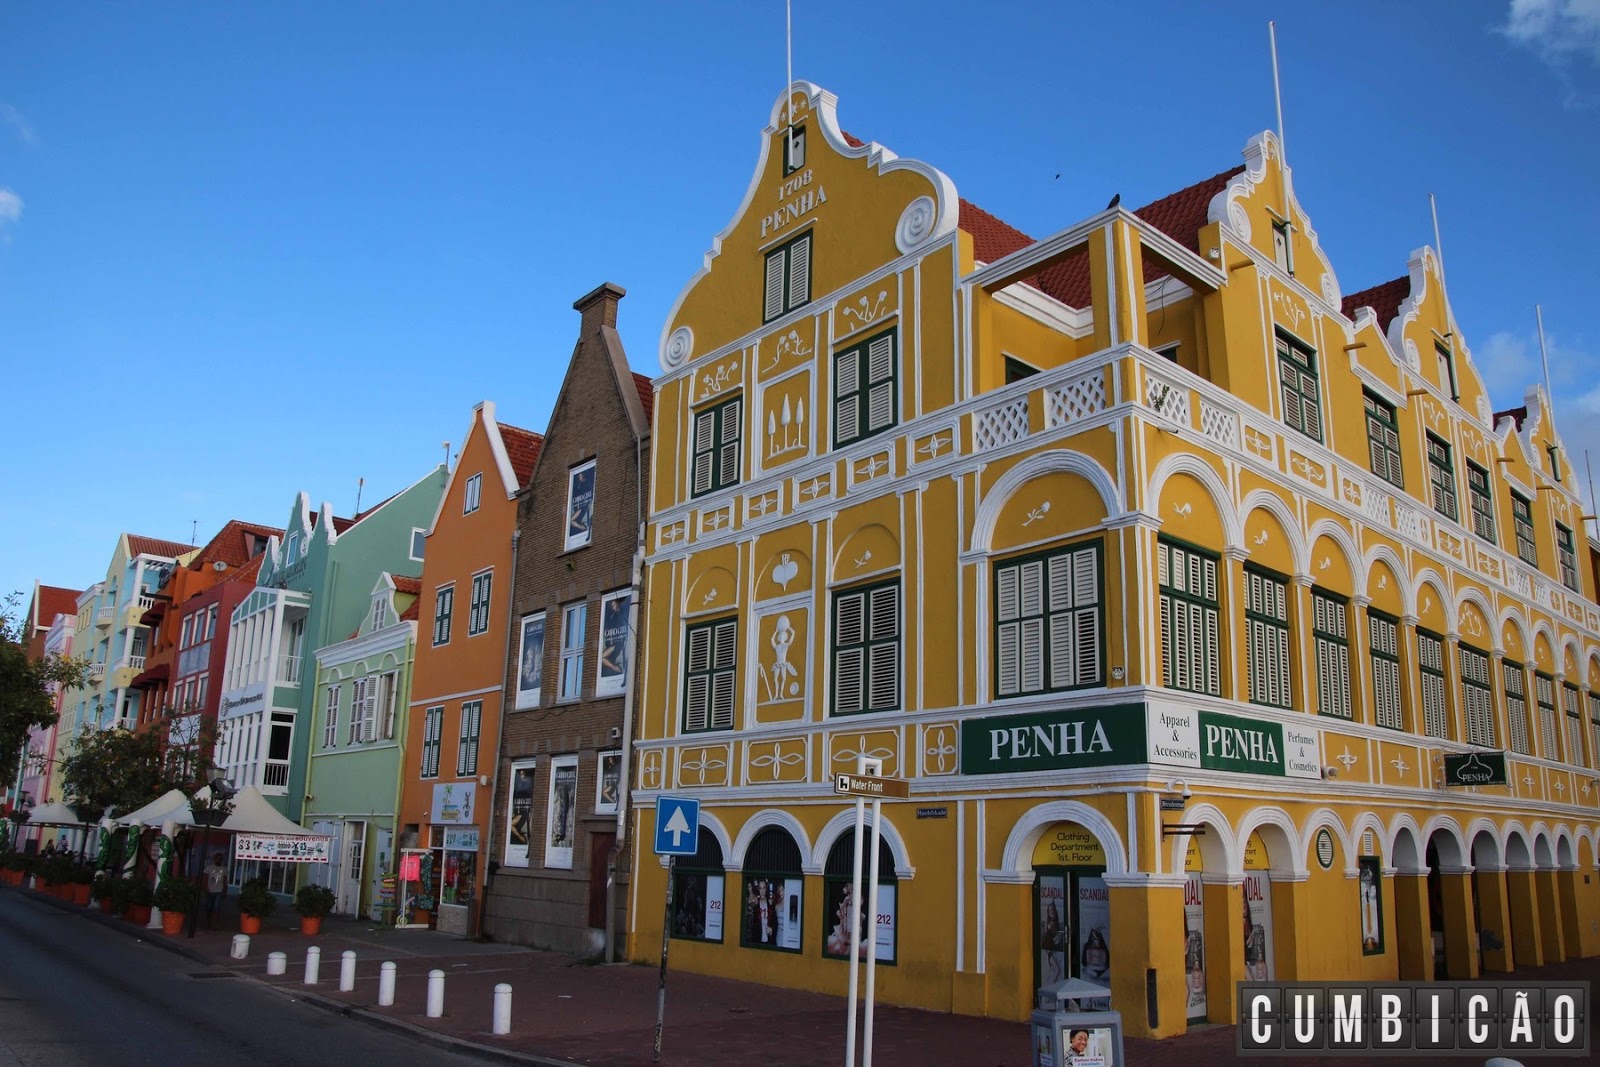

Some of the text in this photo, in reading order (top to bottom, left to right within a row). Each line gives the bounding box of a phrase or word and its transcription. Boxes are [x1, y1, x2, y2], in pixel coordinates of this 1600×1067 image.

[779, 169, 813, 202] 1708
[760, 184, 827, 239] PENHA
[1159, 713, 1190, 728] Apparel
[988, 719, 1113, 760] PENHA
[1172, 729, 1179, 742] &
[1288, 731, 1315, 745] Perfumes
[1205, 724, 1280, 764] PENHA
[1153, 744, 1197, 760] Accessories
[1299, 747, 1305, 757] &
[1289, 759, 1317, 773] Cosmetics
[1462, 773, 1490, 782] PENHA
[851, 779, 883, 792] Water Front
[1056, 832, 1090, 843] Clothing
[1050, 842, 1098, 853] Department
[1057, 853, 1092, 862] 1st. Floor
[1040, 887, 1064, 900] SCANDAL
[710, 900, 721, 910] 212
[876, 914, 891, 925] 212
